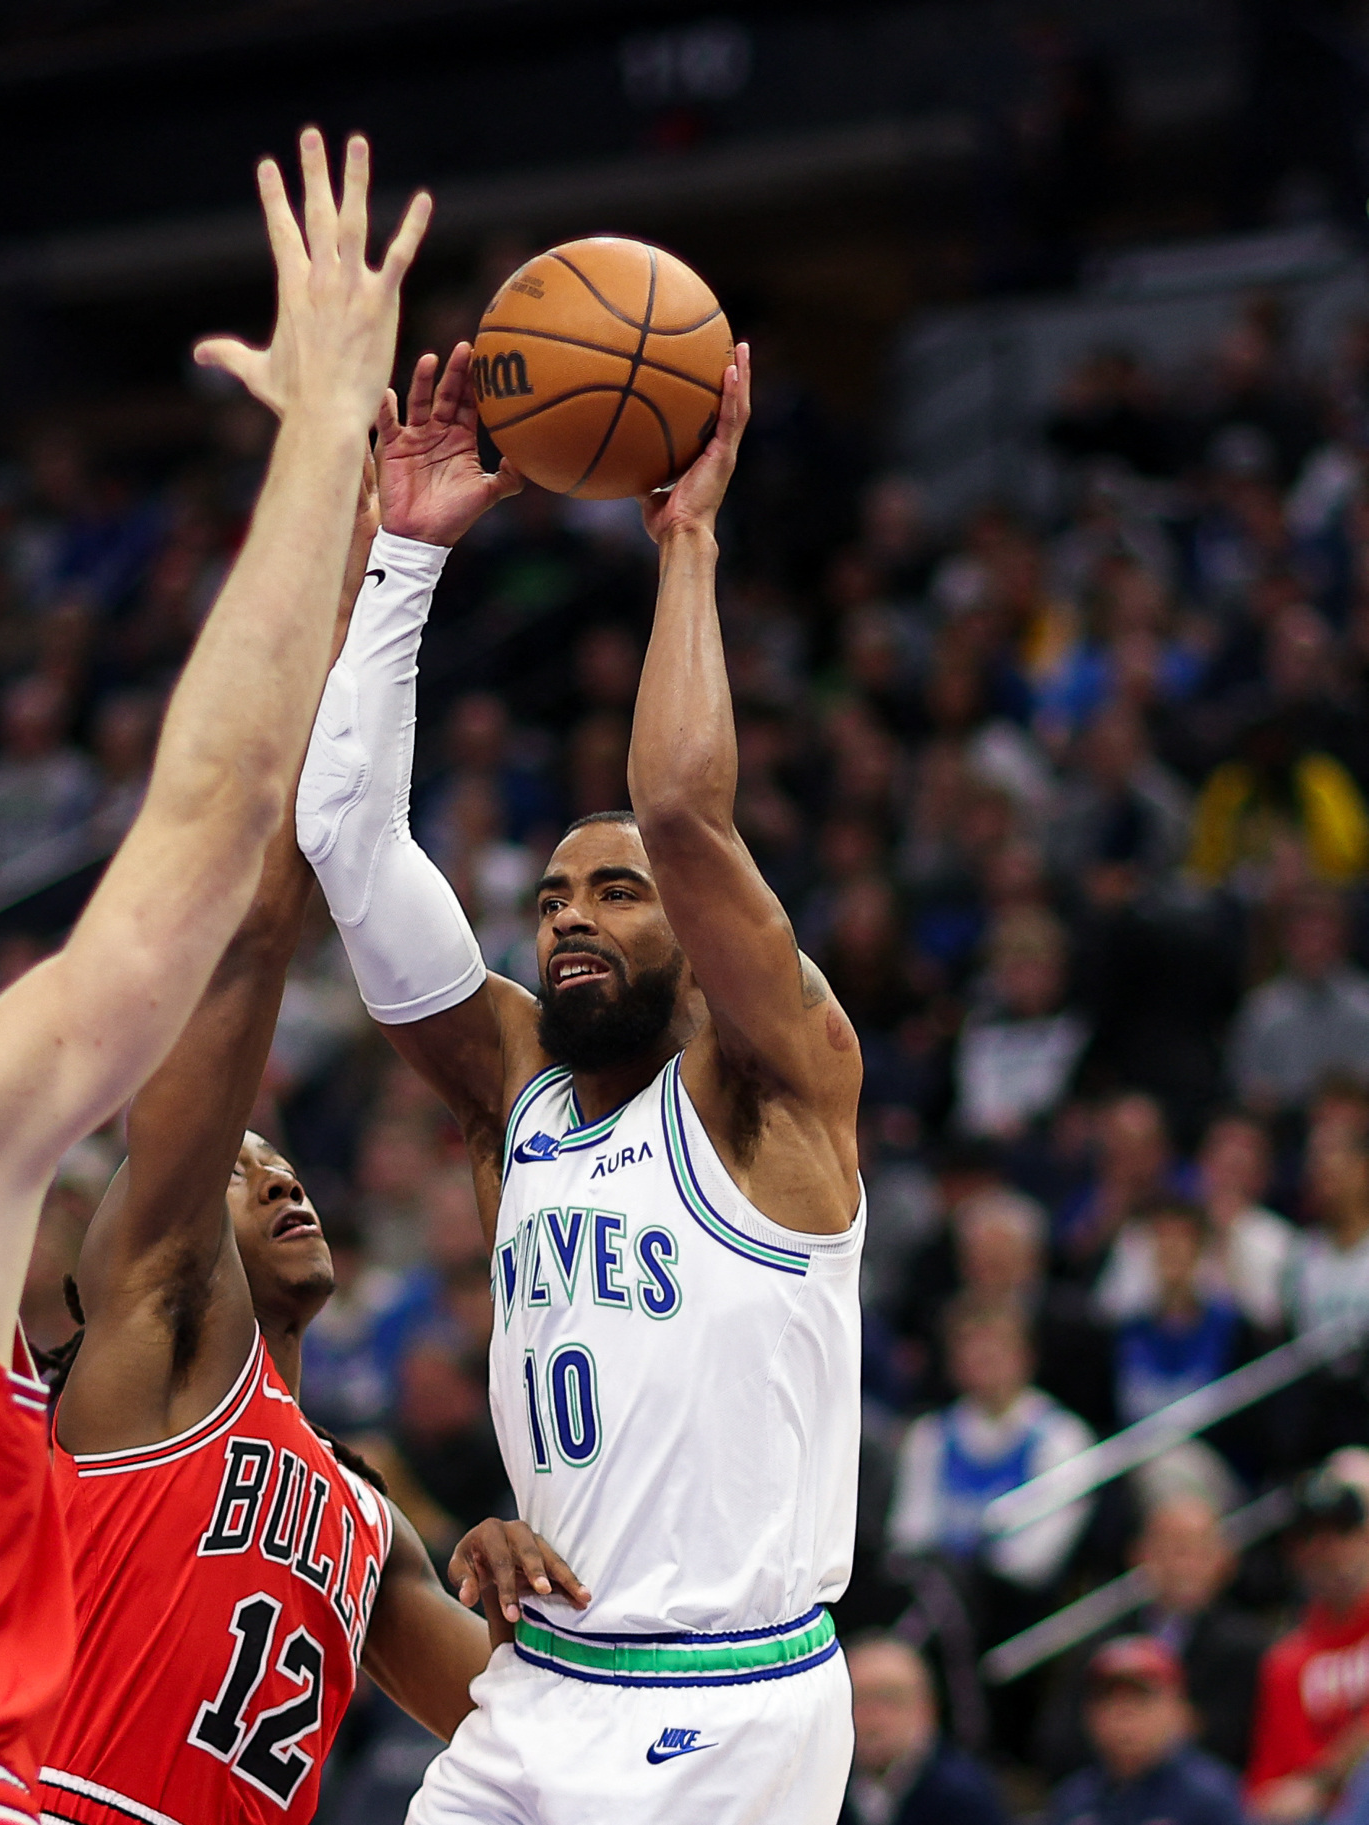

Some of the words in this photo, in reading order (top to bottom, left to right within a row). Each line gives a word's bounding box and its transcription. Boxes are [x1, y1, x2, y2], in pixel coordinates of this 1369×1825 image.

[523, 1342, 603, 1474] 10
[187, 1591, 325, 1811] 12
[656, 1727, 701, 1749] NIKE
